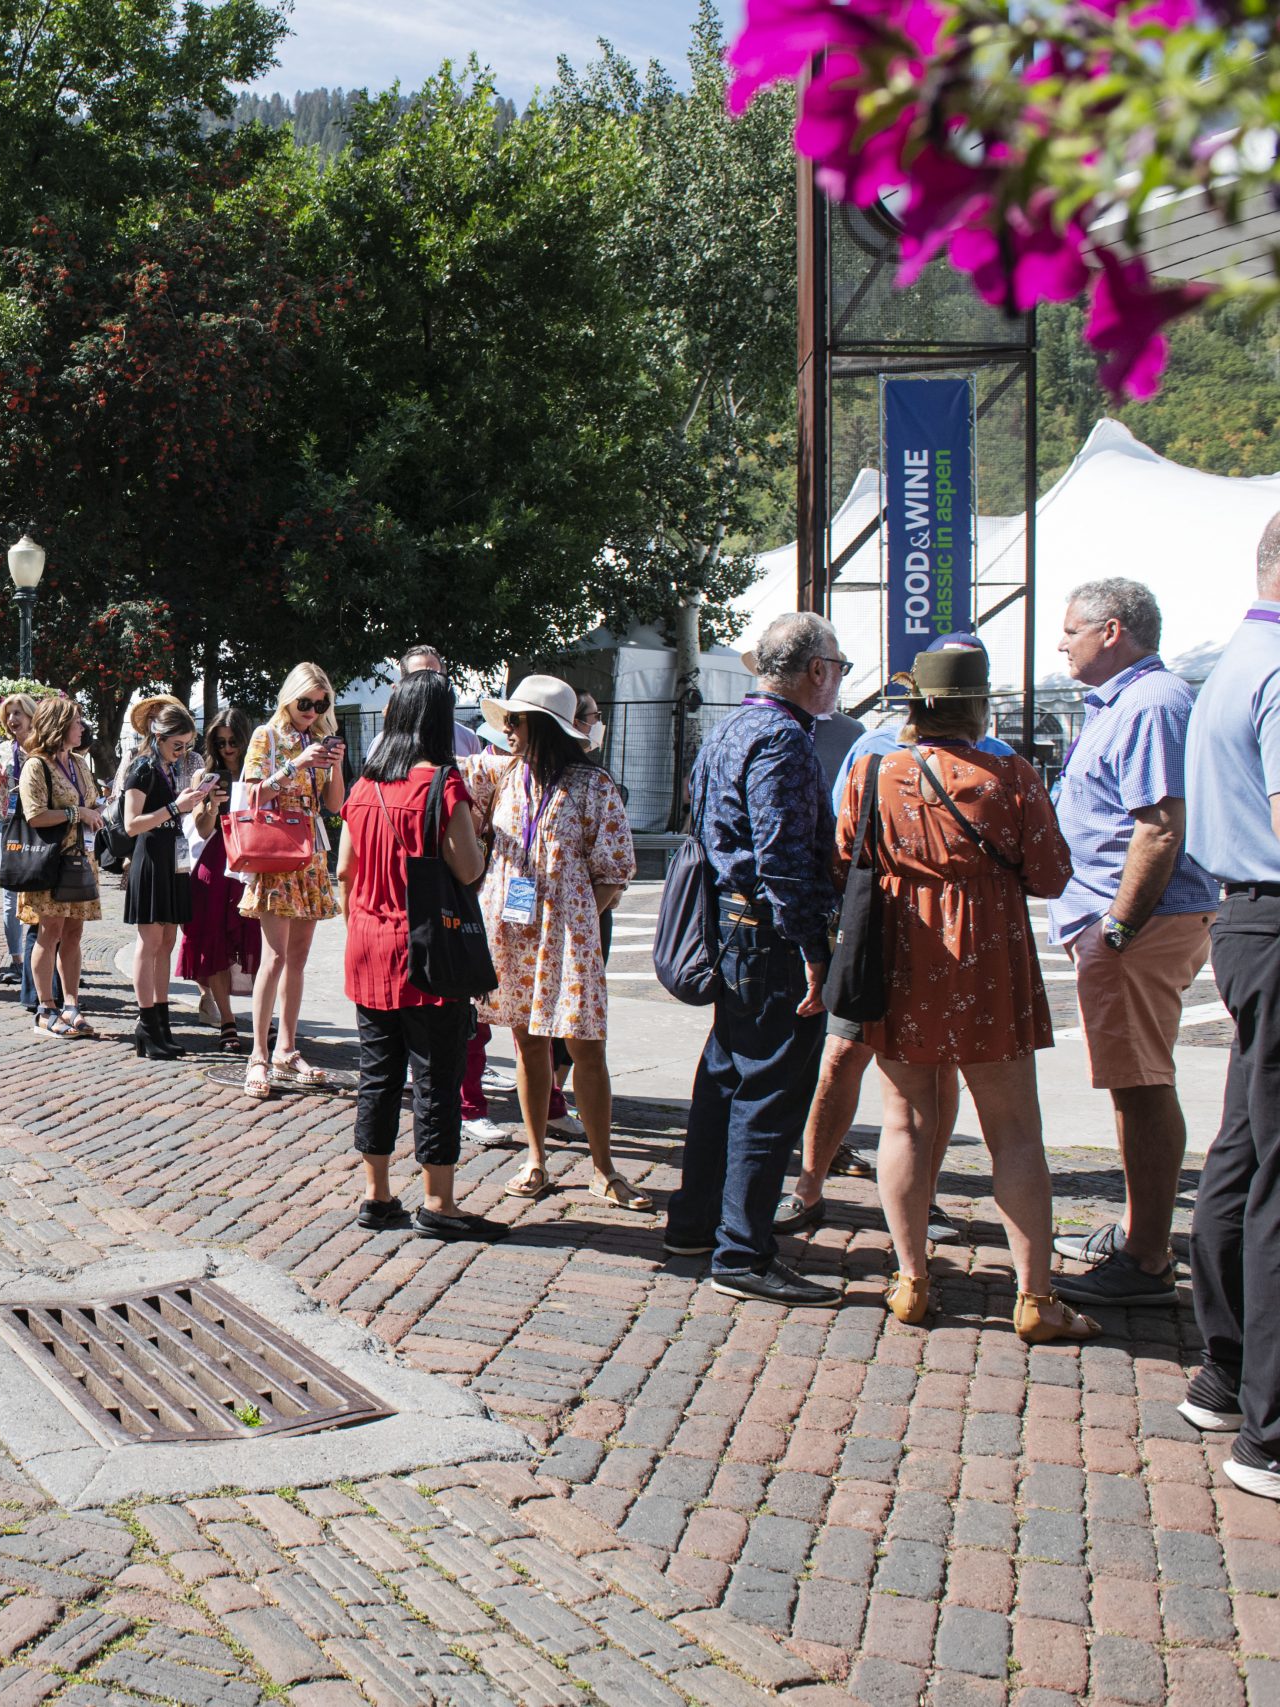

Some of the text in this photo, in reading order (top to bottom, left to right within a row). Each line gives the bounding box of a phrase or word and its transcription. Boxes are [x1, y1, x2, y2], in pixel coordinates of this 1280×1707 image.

[931, 450, 957, 634] classic in aspen
[7, 843, 22, 851] TOP
[442, 915, 461, 929] TOP
